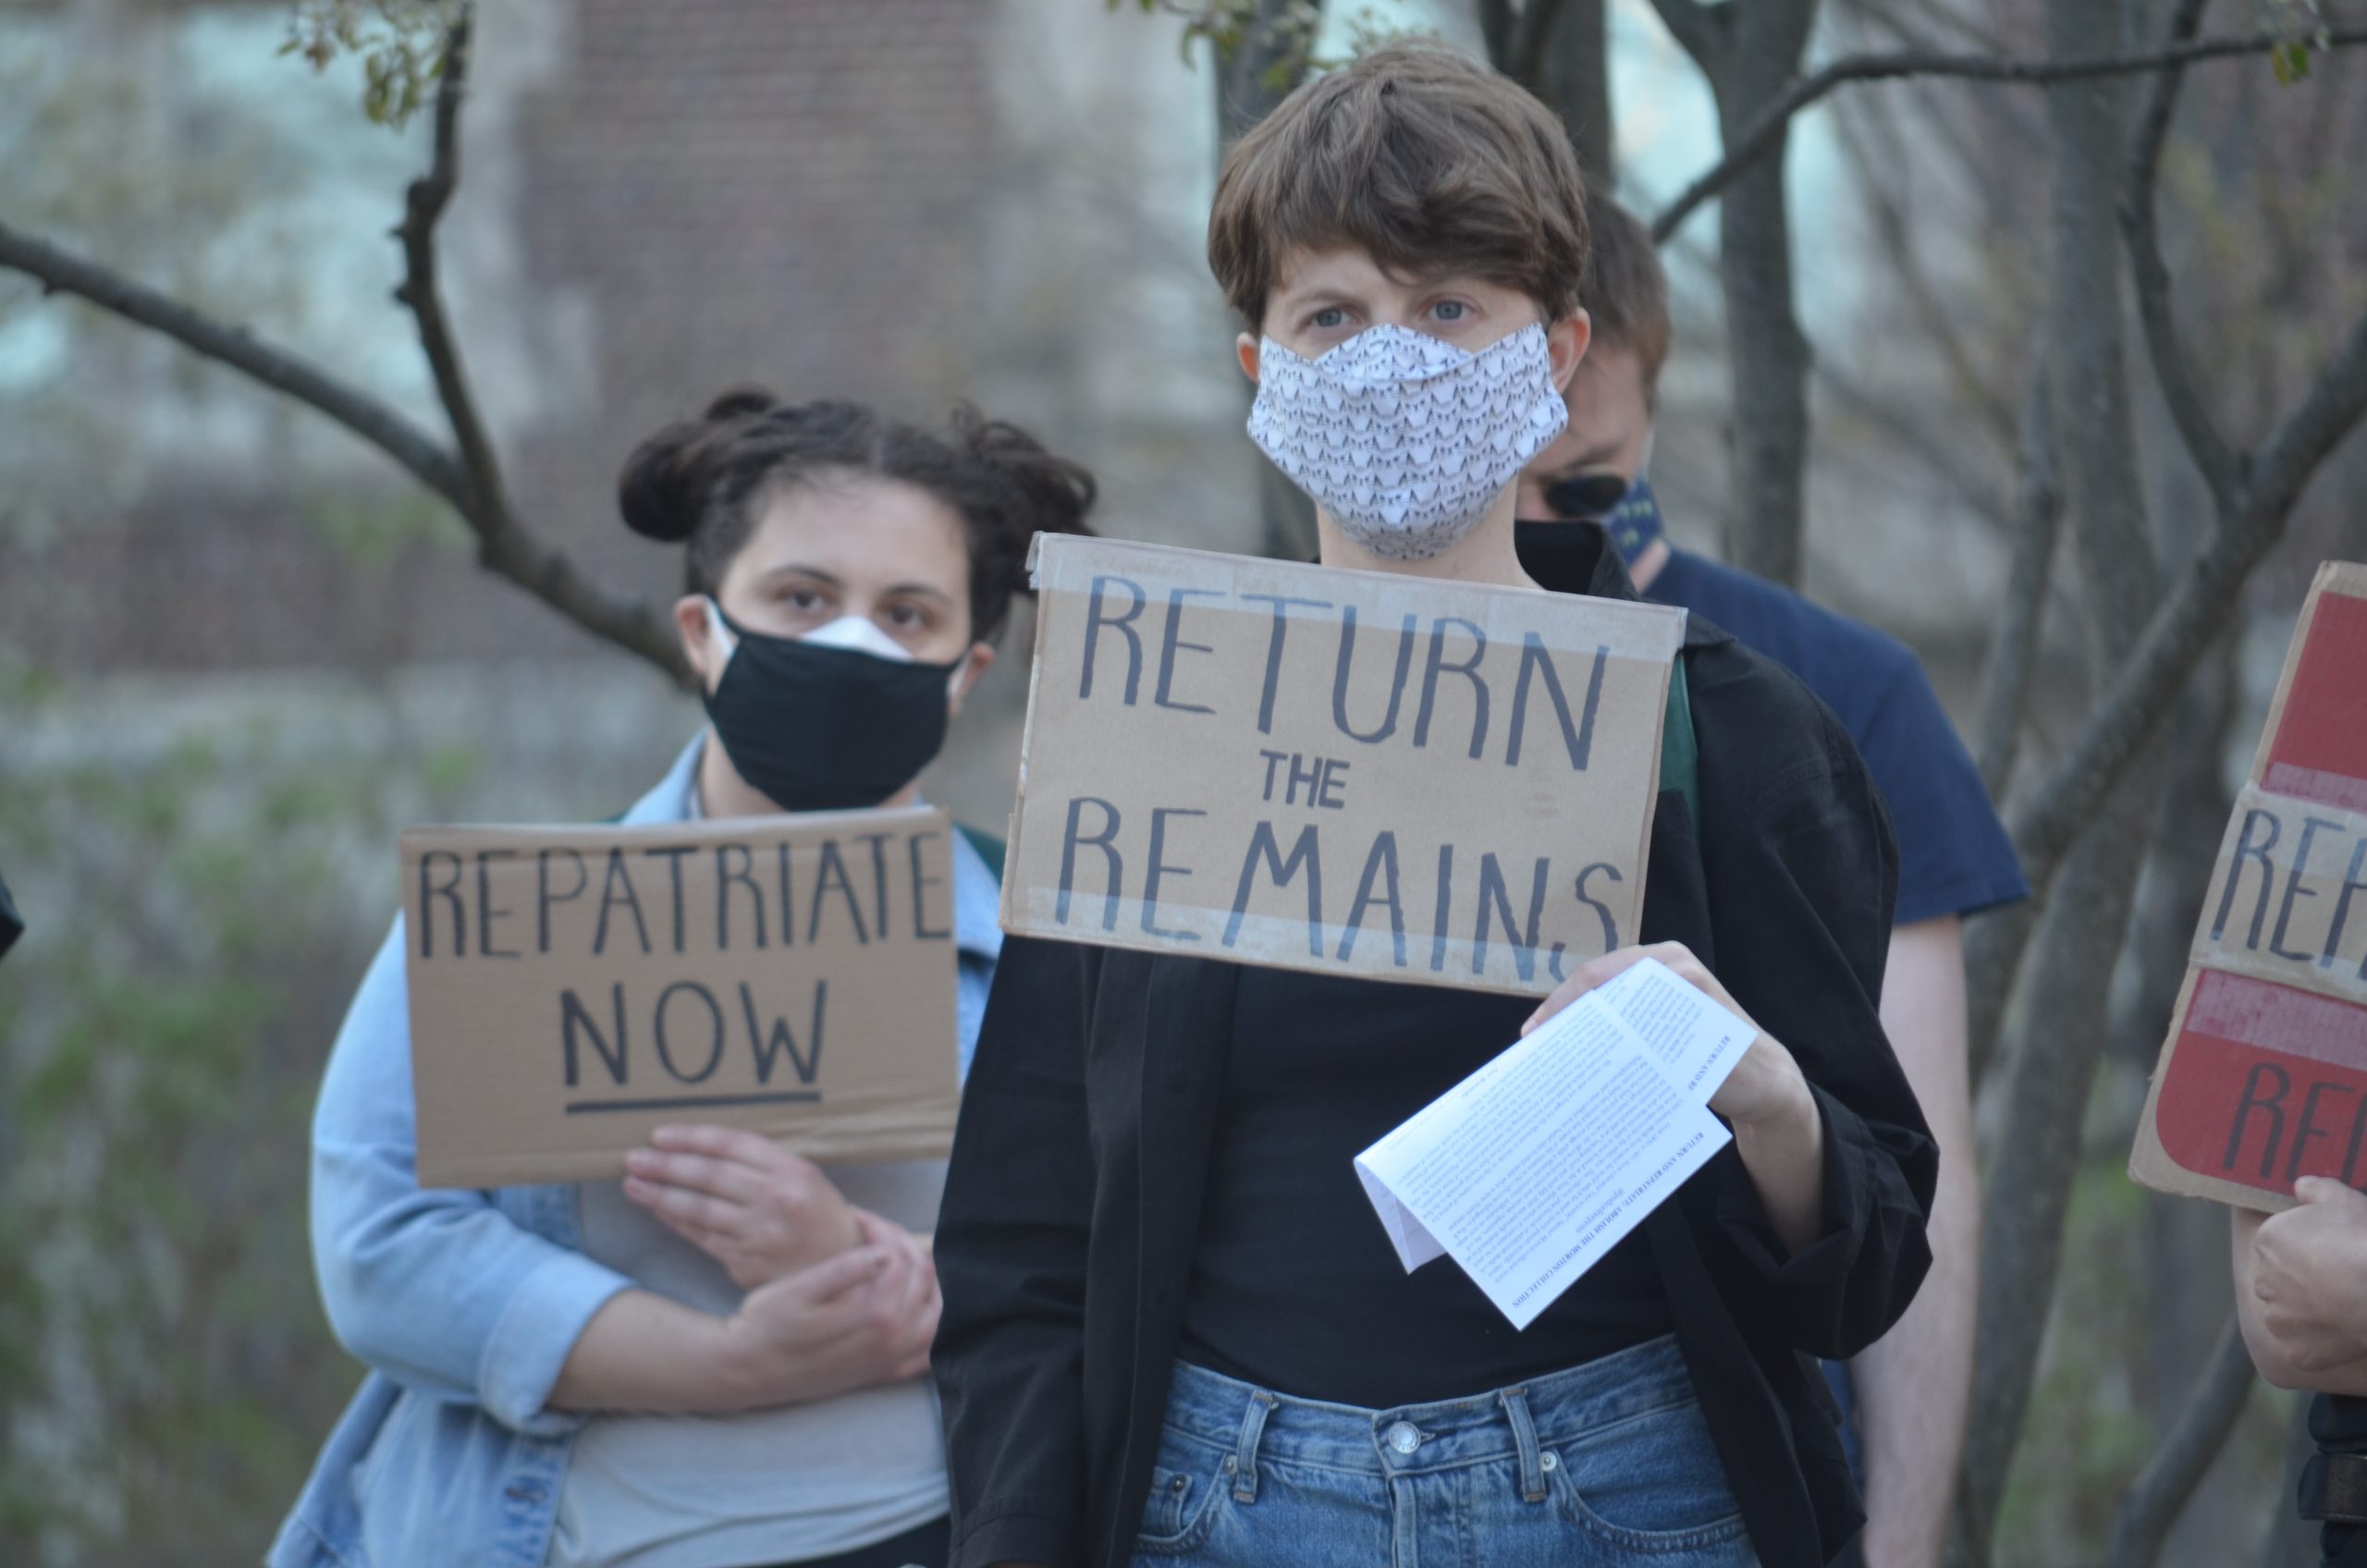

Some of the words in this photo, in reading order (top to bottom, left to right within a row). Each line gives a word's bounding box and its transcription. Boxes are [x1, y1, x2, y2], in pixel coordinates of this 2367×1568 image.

[1079, 575, 1610, 771] RETURN
[1259, 749, 1351, 810] THE
[419, 834, 951, 959] REPATRIATE
[1054, 796, 1624, 984] REMAINS
[2210, 808, 2367, 980] REP
[560, 979, 828, 1087] NOW
[1659, 1154, 1679, 1173] AND
[1674, 1130, 1705, 1158] RETURN
[1577, 1230, 1596, 1247] THE
[1591, 1204, 1625, 1235] ABOLISH
[1550, 1242, 1583, 1273] MORTON
[1510, 1268, 1555, 1309] COLLECTION
